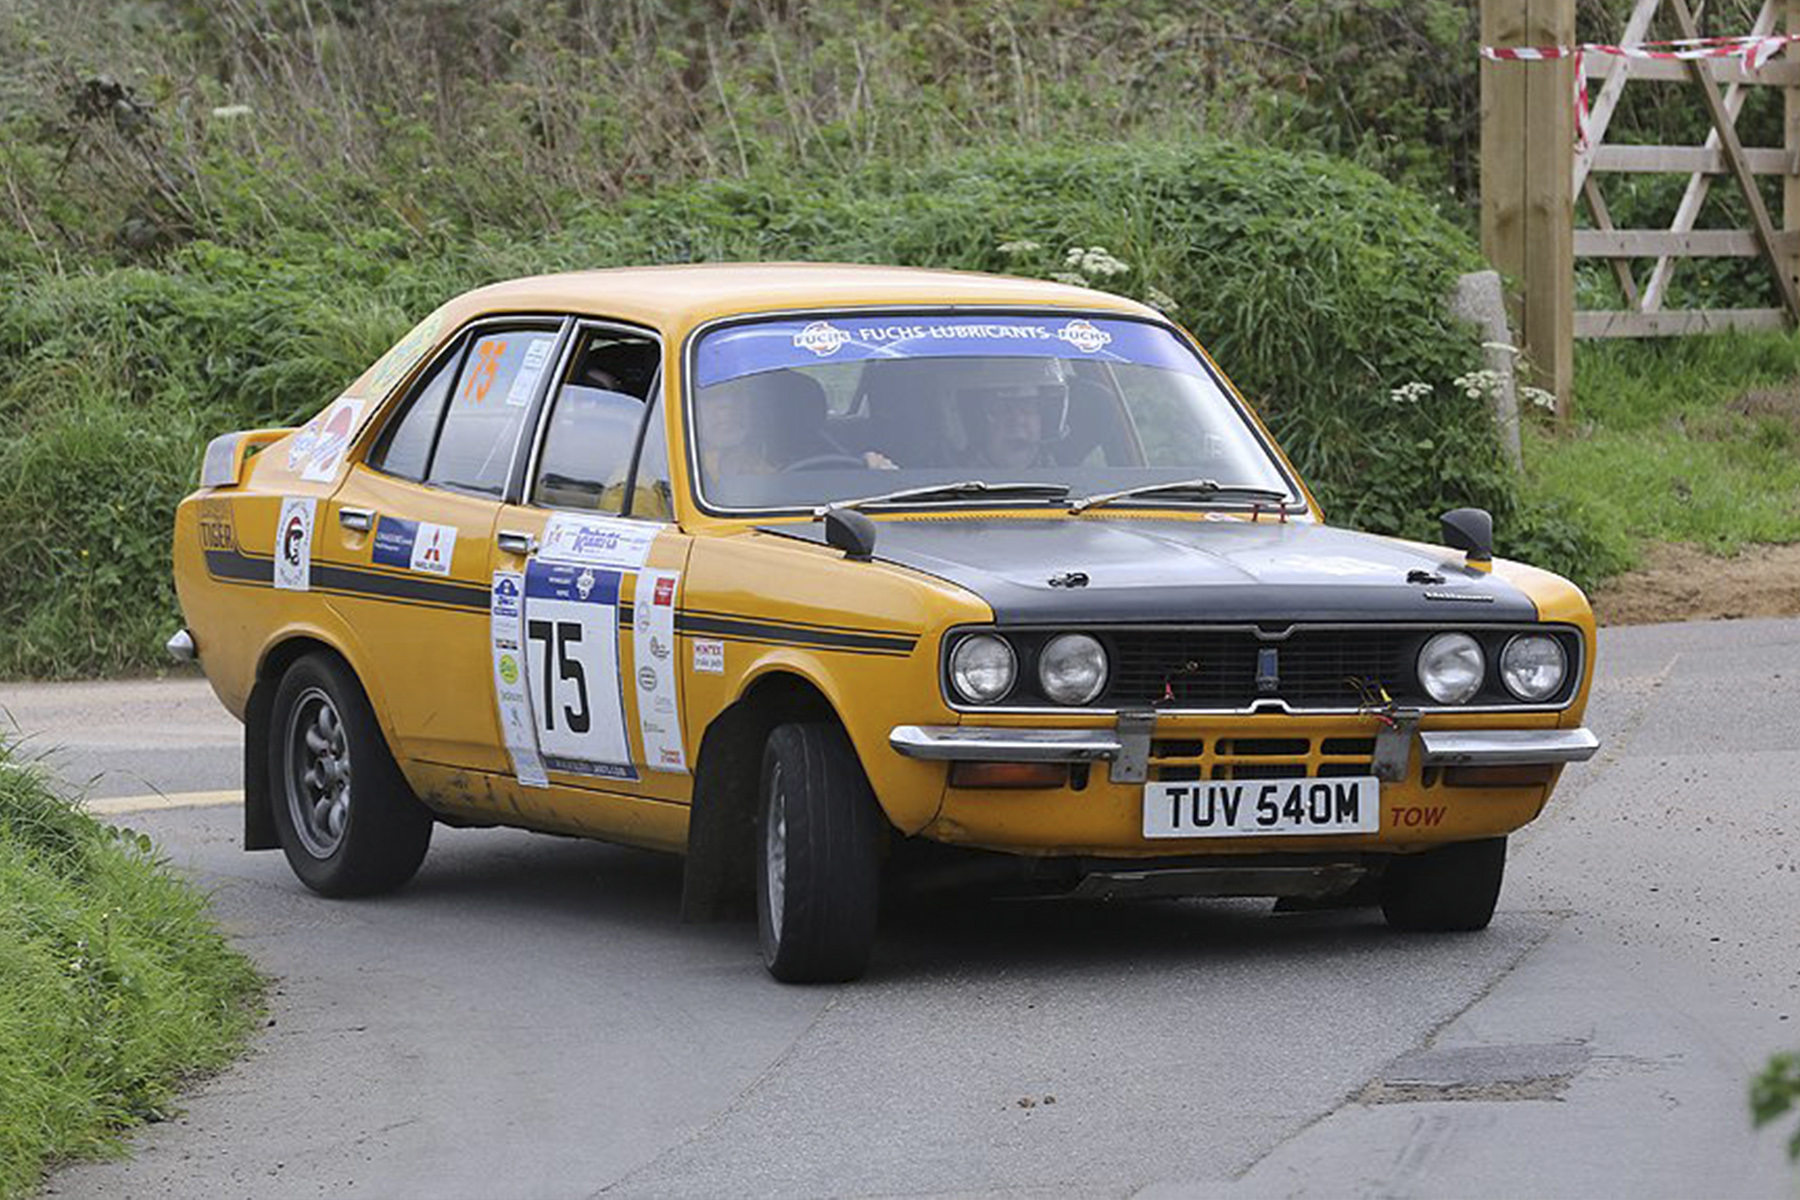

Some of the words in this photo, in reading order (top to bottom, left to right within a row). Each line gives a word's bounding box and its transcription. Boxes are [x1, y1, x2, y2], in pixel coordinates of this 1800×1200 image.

[859, 326, 926, 340] FUCHS
[929, 324, 1050, 339] LUBRICANTS
[1057, 328, 1112, 345] FUCHS
[200, 522, 235, 549] TIGER
[528, 619, 590, 734] 75
[1165, 786, 1244, 828] TUV
[1256, 783, 1359, 826] 540M
[1390, 806, 1447, 828] TOW
